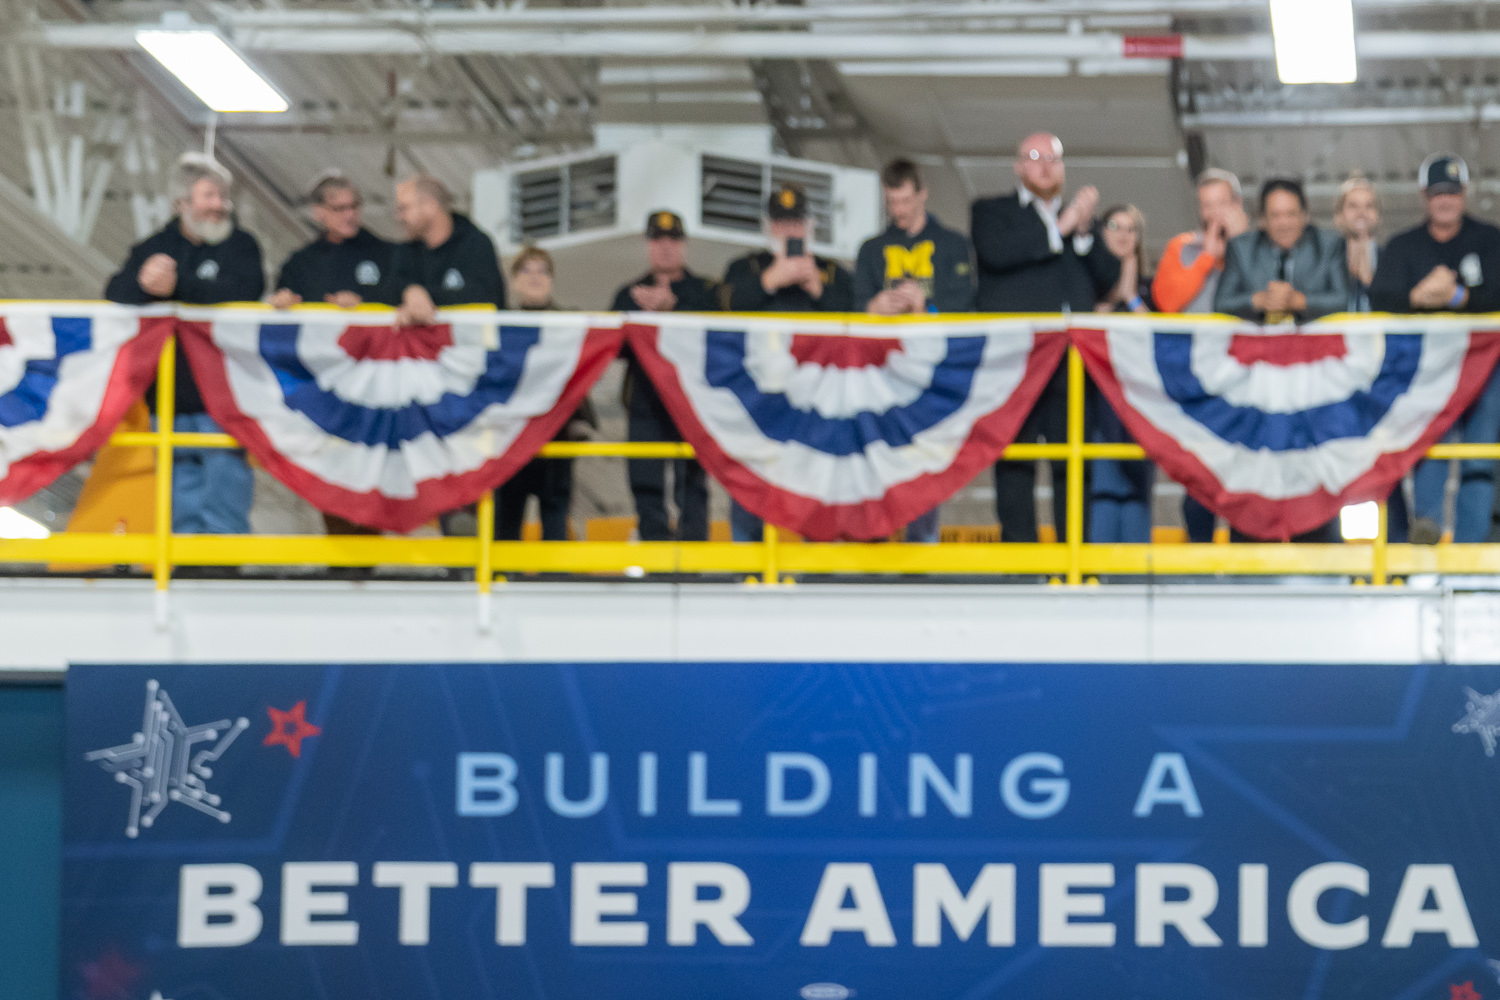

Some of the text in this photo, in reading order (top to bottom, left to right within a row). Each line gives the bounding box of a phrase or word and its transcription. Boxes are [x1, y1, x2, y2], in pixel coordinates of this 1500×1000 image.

[883, 240, 936, 280] M
[455, 752, 1204, 819] BUILDING A
[177, 861, 1480, 950] BETTER AMERICA
